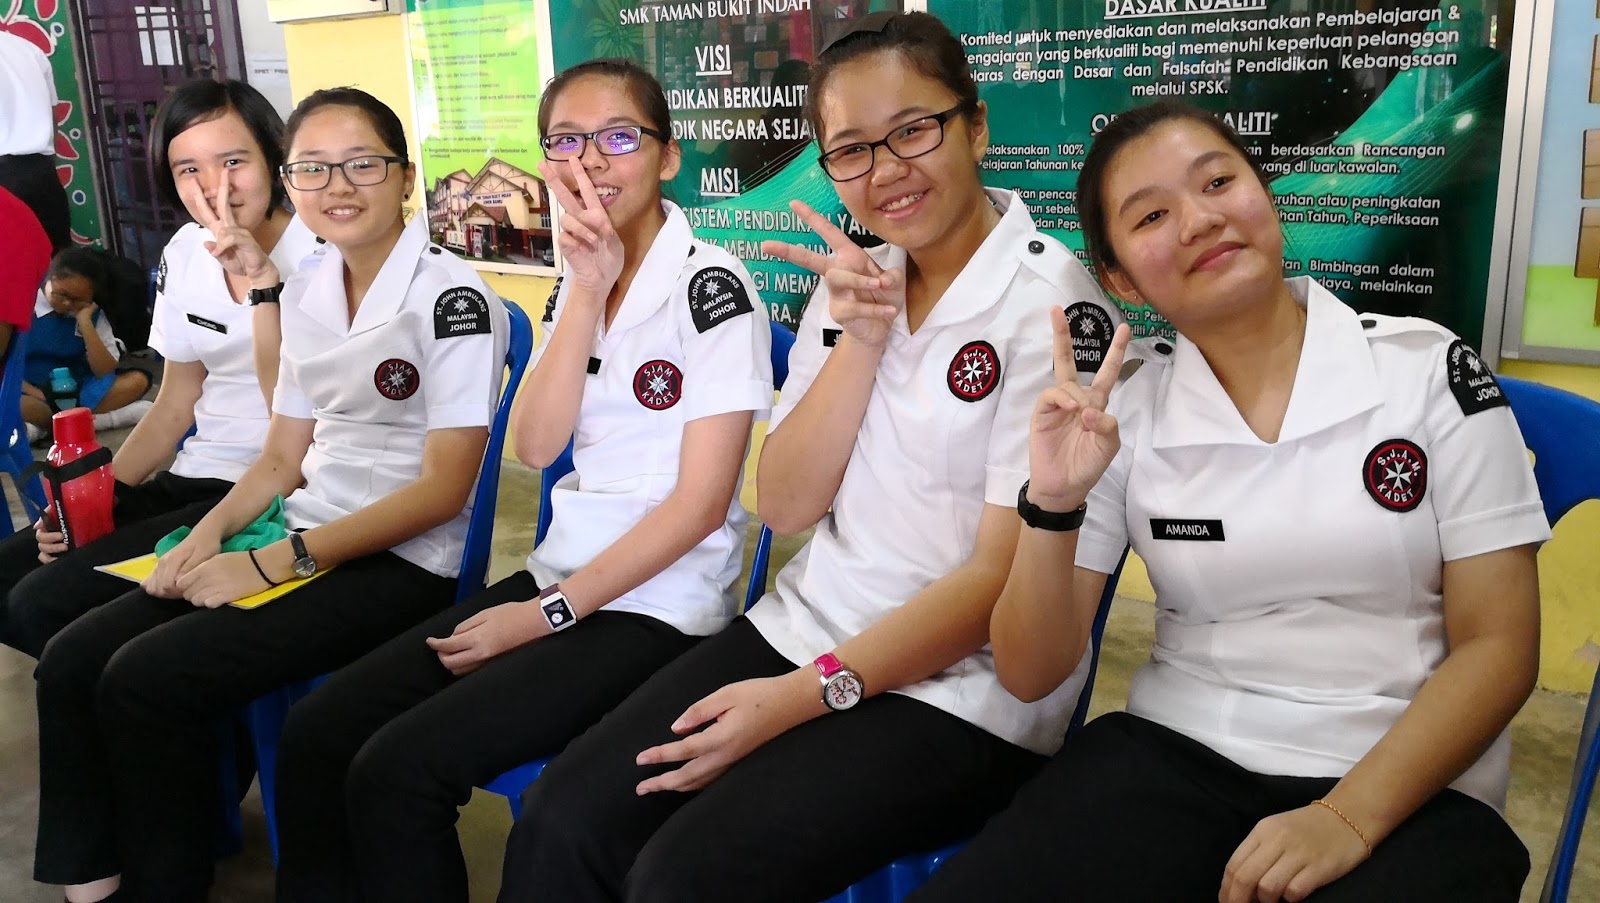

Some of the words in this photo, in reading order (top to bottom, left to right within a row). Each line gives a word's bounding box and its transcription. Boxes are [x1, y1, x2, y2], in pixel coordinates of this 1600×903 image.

[620, 8, 649, 25] SMK
[652, 3, 703, 22] TAMAN
[707, 0, 751, 18] BUKIT
[758, 0, 811, 14] INDAH
[1105, 0, 1177, 16] DASAR
[961, 31, 1012, 46] Komited
[1015, 29, 1051, 45] untuk
[1055, 22, 1153, 43] menyediakan
[1157, 22, 1187, 36] dan
[1191, 15, 1311, 34] melaksanakan
[1316, 7, 1442, 27] Pembelajaran
[1448, 5, 1460, 20] &
[965, 50, 1032, 66] engajaran
[1036, 50, 1070, 64] yang
[1074, 44, 1138, 60] berkualiti
[1142, 41, 1175, 58] bagi
[1180, 37, 1263, 54] memenuhi
[1267, 34, 1352, 56] keperluan
[1357, 30, 1459, 50] pelanggan
[695, 44, 732, 72] VISI
[970, 69, 1004, 82] laras
[1012, 67, 1064, 83] dengan
[1074, 65, 1113, 79] Dasar
[1123, 63, 1152, 77] dan
[1162, 59, 1225, 76] Falsafah
[1236, 57, 1329, 74] Pendidikan
[1341, 52, 1458, 70] Kebangsaan
[1132, 82, 1185, 96] melalui
[1189, 80, 1229, 95] SPSK.
[664, 88, 719, 109] IDIKAN
[702, 118, 769, 140] NEGARA
[985, 144, 1050, 156] elaksanakan
[1058, 144, 1085, 156] 100%
[1271, 144, 1355, 157] berdasarkan
[1363, 144, 1445, 159] Rancangan
[980, 159, 1022, 171] elajaran
[1025, 160, 1068, 170] Tahunan
[1295, 161, 1307, 173] di
[1310, 161, 1335, 173] luar
[1338, 161, 1401, 174] kawalan.
[701, 167, 740, 193] MISI
[1318, 195, 1348, 207] atau
[1352, 196, 1441, 210] peningkatan
[1036, 217, 1055, 228] dan
[1307, 210, 1349, 225] Tahun,
[1354, 212, 1439, 227] Peperiksaan
[1310, 260, 1379, 276] Bimbingan
[1389, 264, 1434, 277] dalam
[692, 278, 703, 299] JOHN
[702, 270, 740, 289] AMBULANS
[1360, 280, 1433, 294] melainkan
[440, 292, 456, 307] JOHN
[457, 290, 487, 313] AMBULANS
[702, 291, 734, 312] MALAYSIA
[709, 301, 737, 321] JOHOR
[446, 313, 478, 322] MALAYSIA
[449, 321, 477, 332] JOHOR
[1066, 308, 1080, 323] OHN
[1082, 305, 1111, 340] AMBULANS
[643, 364, 673, 377] SJAM
[953, 370, 983, 393] KADET
[642, 391, 675, 406] KADET
[1377, 483, 1414, 502] KADET
[1165, 524, 1210, 537] AMANDA
